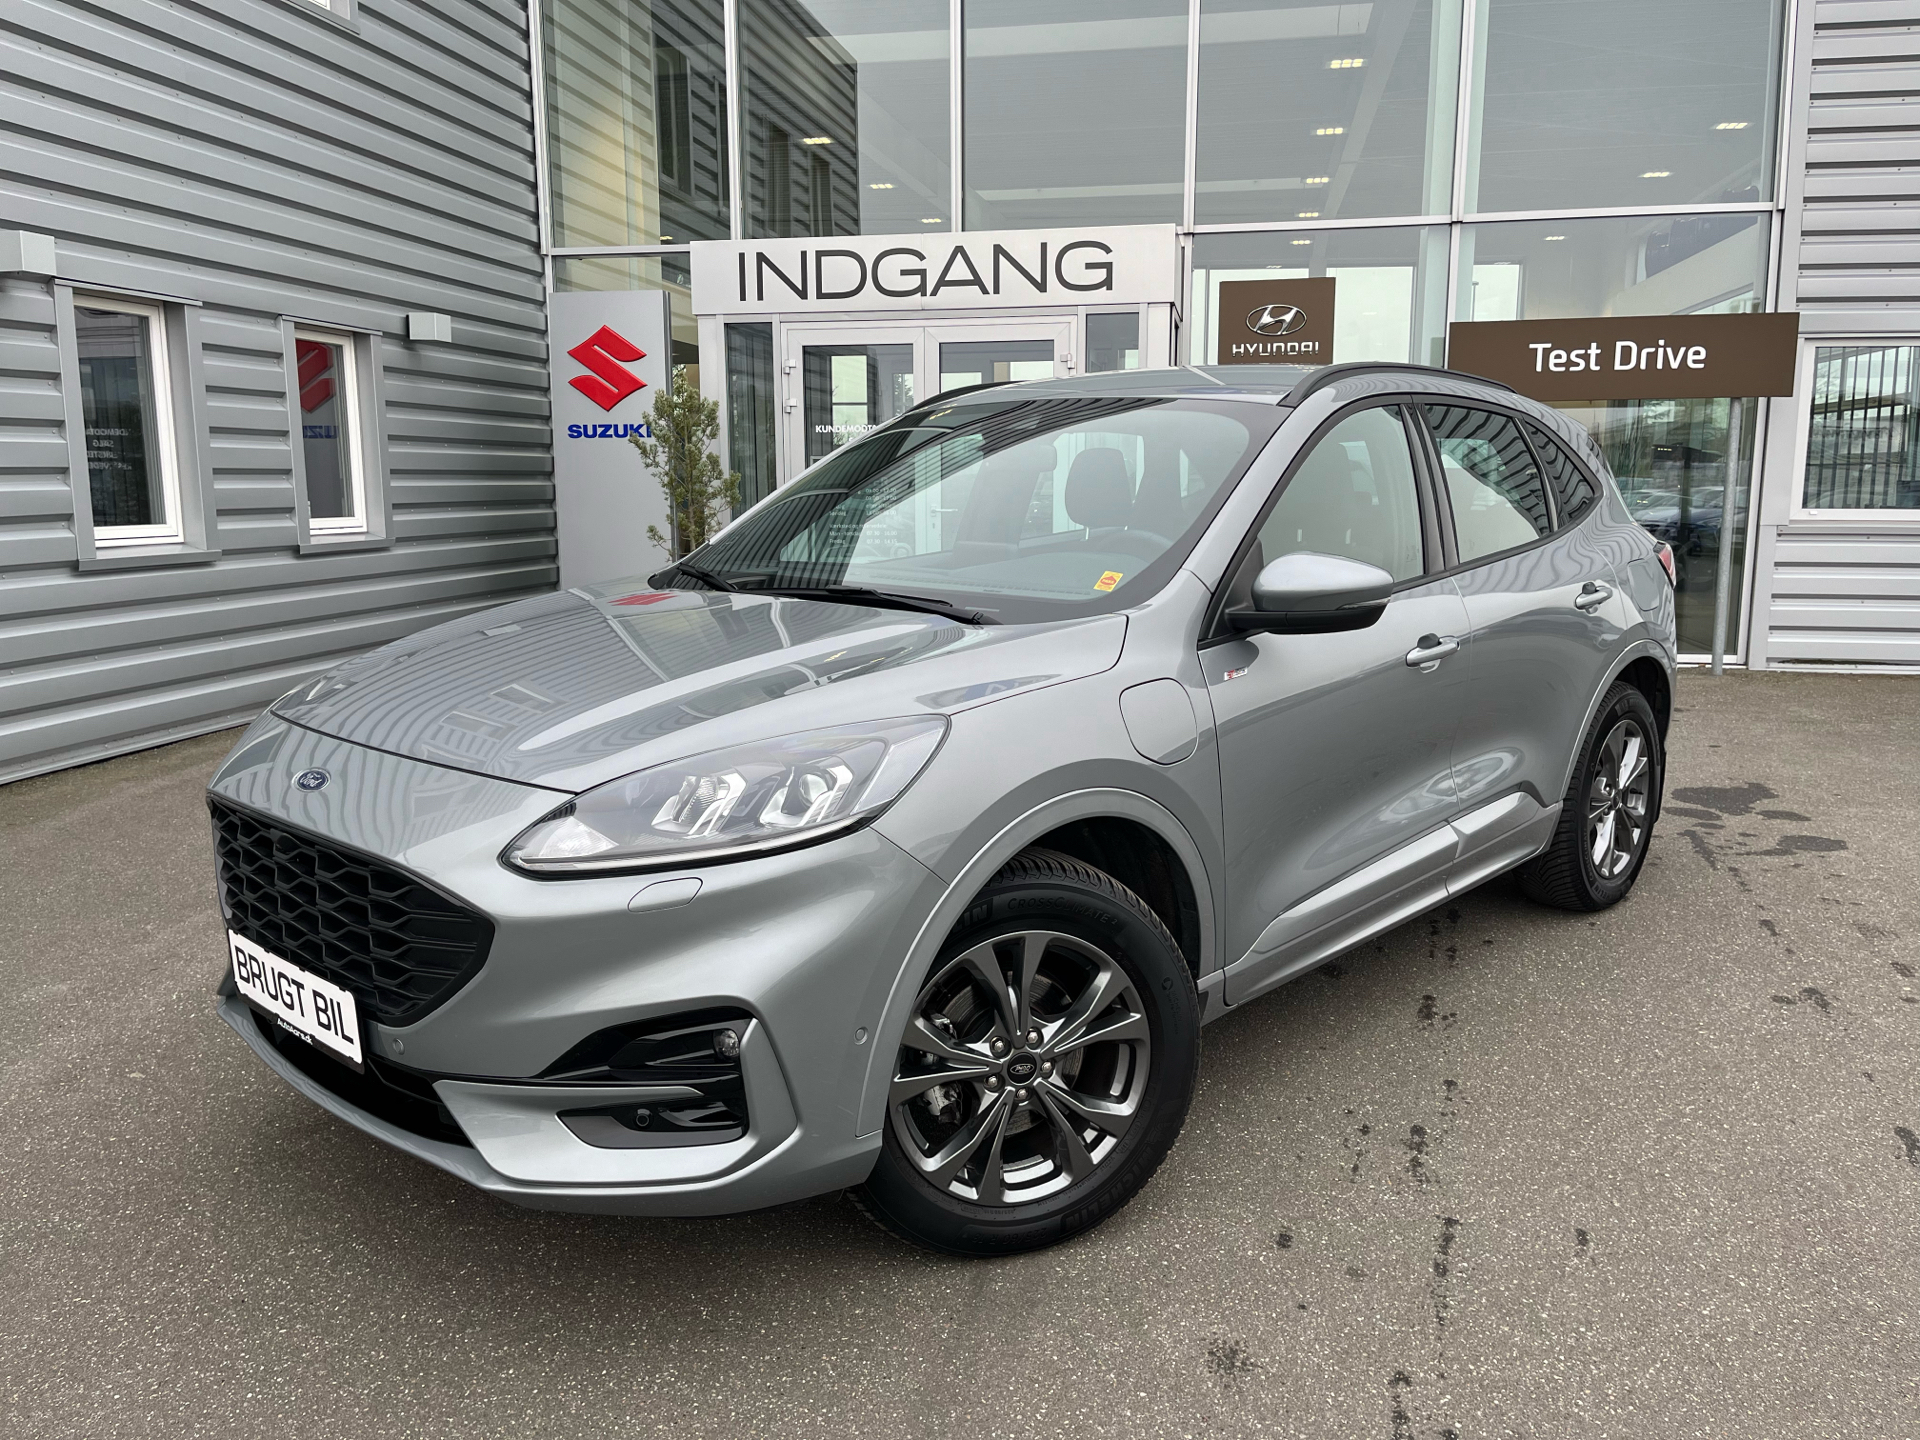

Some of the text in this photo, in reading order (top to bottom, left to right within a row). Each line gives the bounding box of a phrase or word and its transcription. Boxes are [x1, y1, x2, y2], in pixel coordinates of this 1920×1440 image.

[738, 240, 1113, 301] INDGANG
[1232, 341, 1319, 357] HYUNDAI
[1528, 339, 1707, 372] Test Drive
[567, 423, 653, 439] SUZUKI
[234, 945, 355, 1045] BRUGT BIL
[1065, 1147, 1154, 1232] MICHELIN
